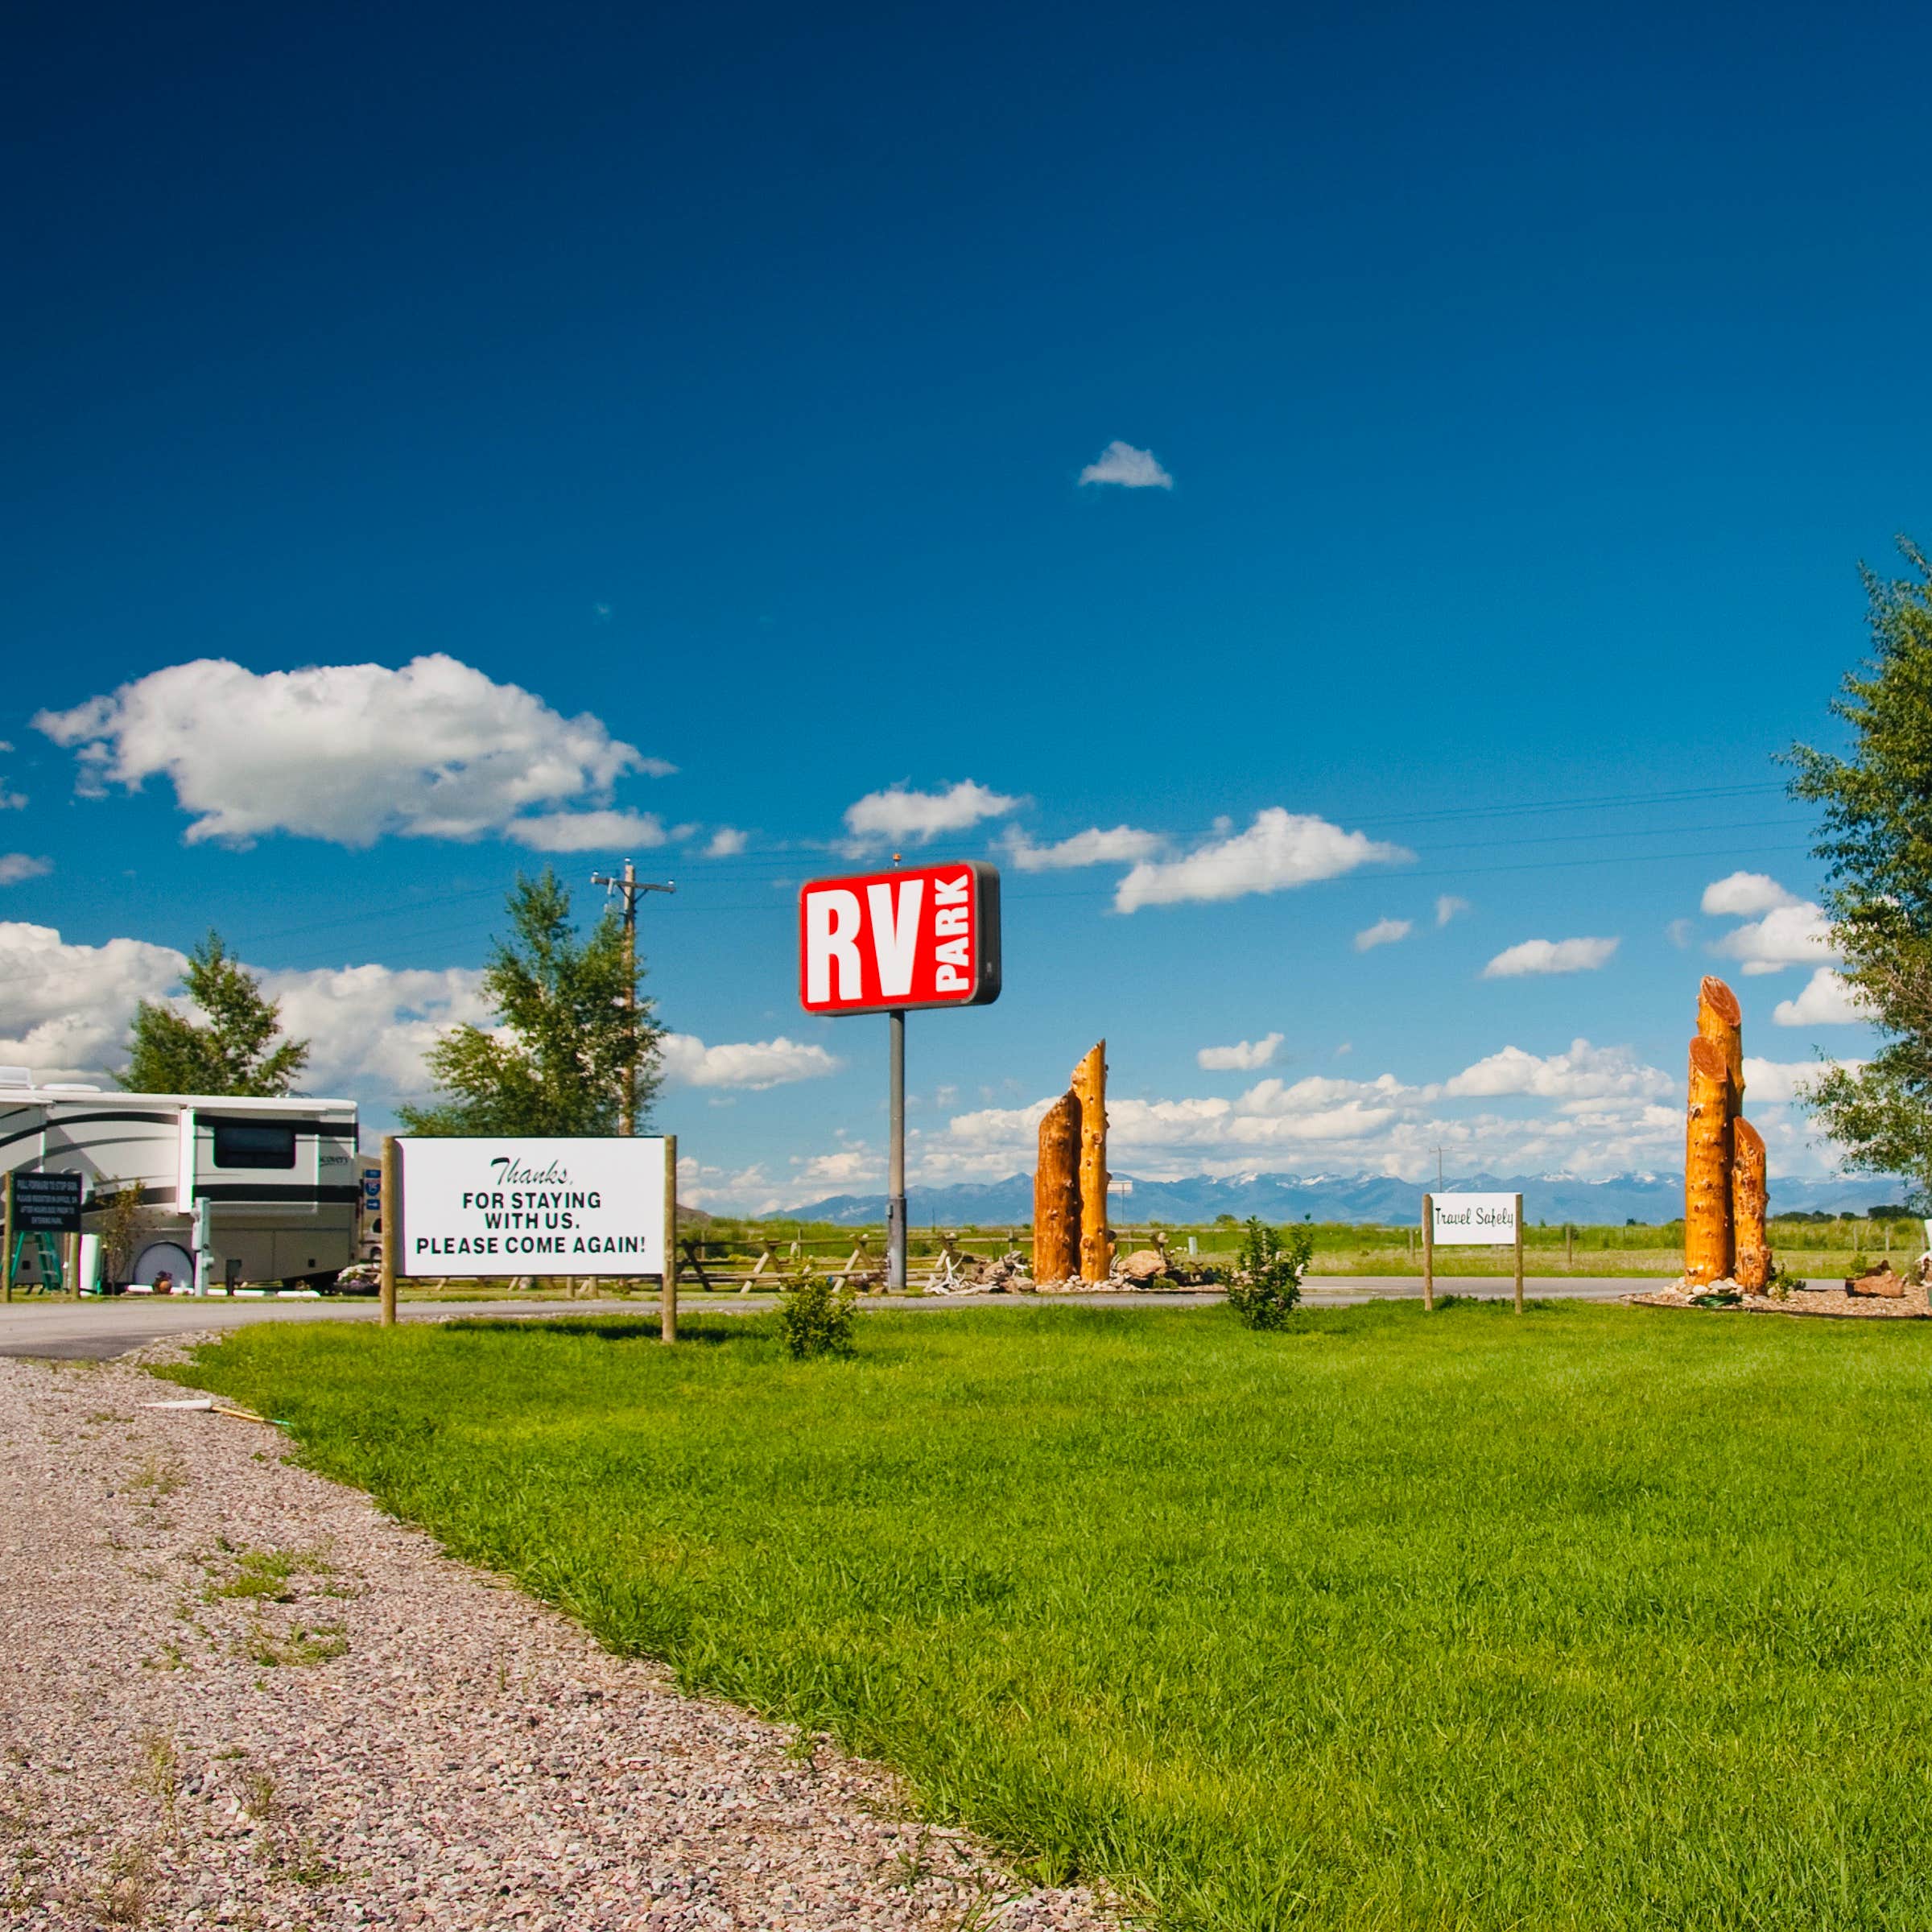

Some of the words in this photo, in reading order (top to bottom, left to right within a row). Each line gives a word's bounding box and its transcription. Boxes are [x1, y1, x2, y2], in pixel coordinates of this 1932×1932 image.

[807, 879, 923, 1003] RV
[935, 874, 969, 992] PARK
[463, 1192, 504, 1209] FOR
[511, 1191, 601, 1209] STAYING
[485, 1212, 538, 1229] WITH
[546, 1212, 580, 1229] US.
[1435, 1207, 1471, 1224] Travel
[1476, 1208, 1513, 1228] Safely
[416, 1237, 498, 1254] PLEASE
[506, 1236, 565, 1253] COME
[573, 1236, 646, 1253] AGAIN!
